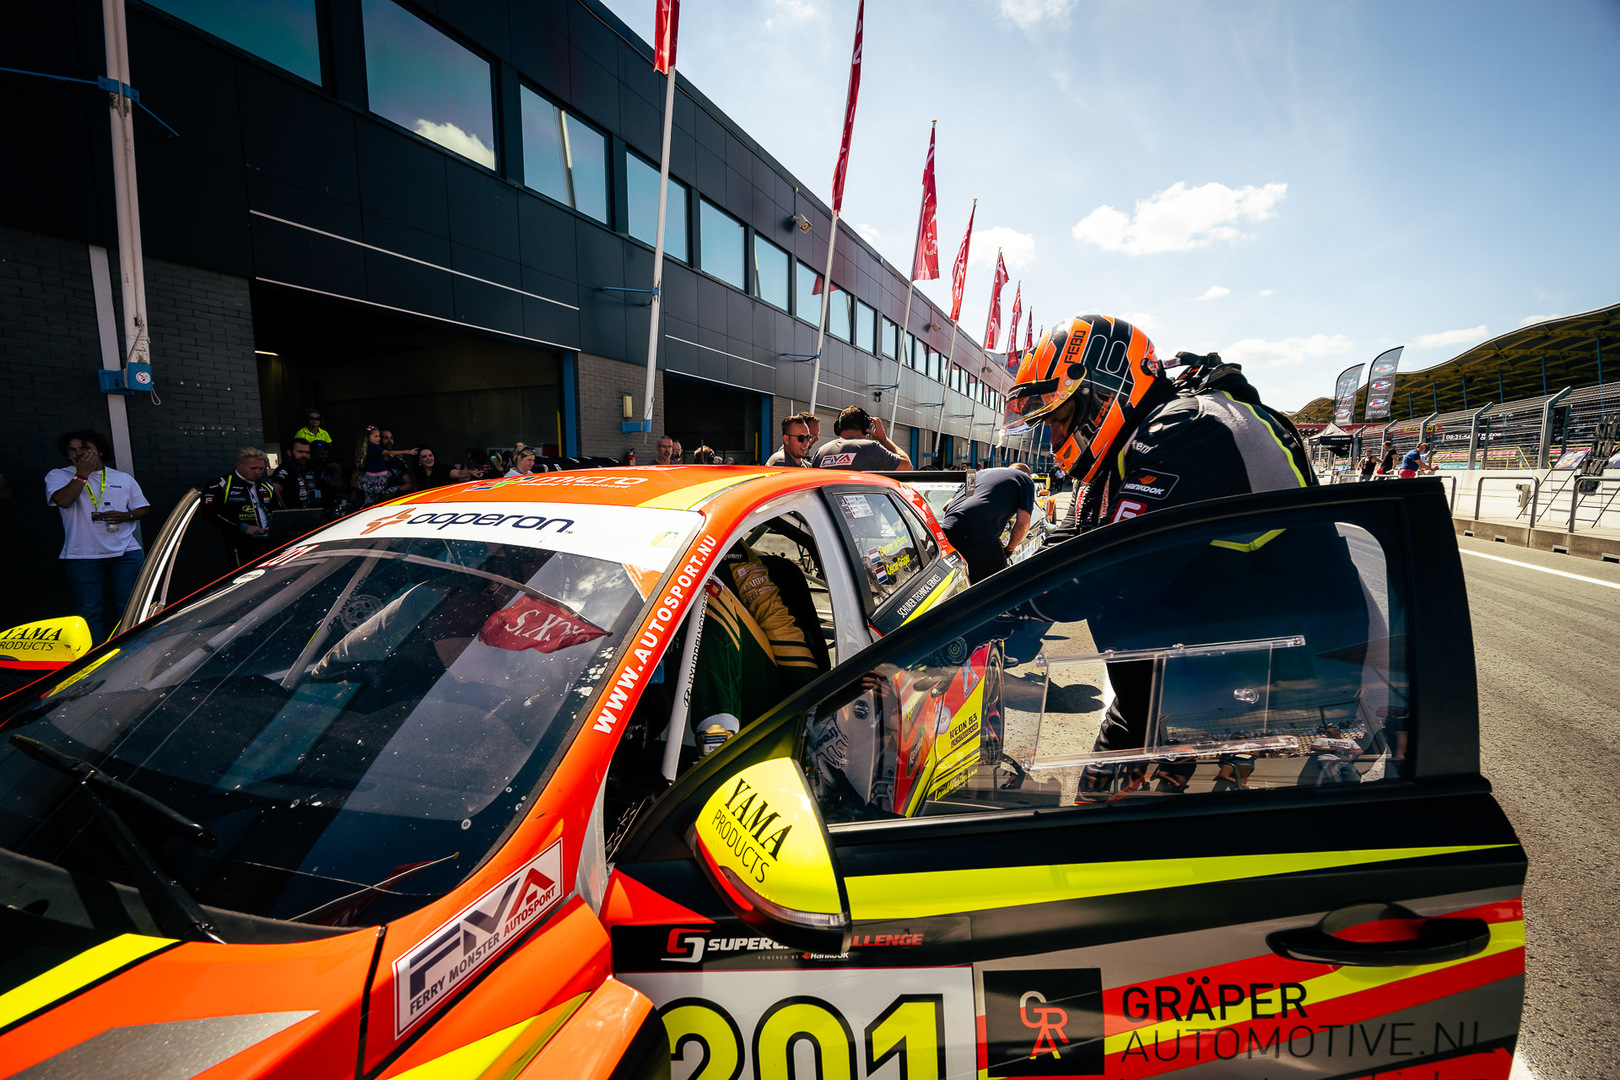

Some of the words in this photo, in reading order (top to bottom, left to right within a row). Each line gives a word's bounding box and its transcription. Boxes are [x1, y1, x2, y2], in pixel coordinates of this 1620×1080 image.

[1064, 330, 1087, 364] FEBO
[528, 475, 648, 485] micro
[0, 641, 56, 652] RODUCTS
[593, 534, 717, 735] WWW.AUTOSPORT.NU
[711, 809, 770, 883] PRODUCTS
[724, 777, 793, 861] YAMA
[409, 976, 446, 1017] FERRY
[448, 932, 501, 985] MONSTER
[503, 884, 556, 938] AUTOSPORT
[708, 936, 790, 951] SUPERC
[850, 933, 924, 947] LLENGE
[1121, 976, 1309, 1023] GRÄPER
[656, 993, 946, 1080] 201
